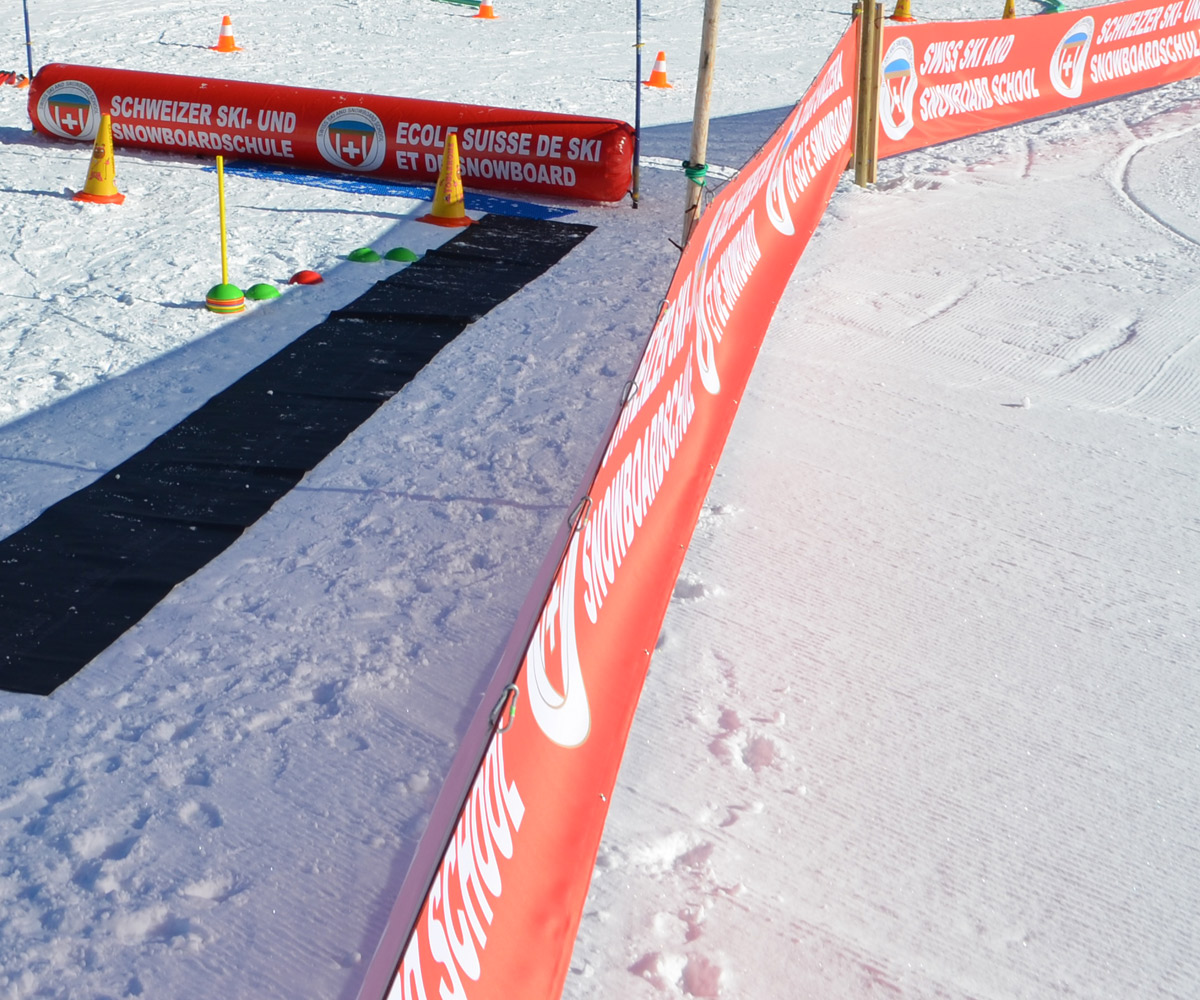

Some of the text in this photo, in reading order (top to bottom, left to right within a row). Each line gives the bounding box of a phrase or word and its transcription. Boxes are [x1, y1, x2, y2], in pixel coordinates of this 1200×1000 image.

[1096, 6, 1165, 45] SCHWEIZER
[1159, 1, 1185, 30] SKI-
[919, 40, 964, 76] SWISS
[959, 37, 989, 70] SKI
[982, 34, 1015, 67] AND
[1090, 28, 1200, 84] SNOWBOARDSCHUL
[991, 67, 1040, 106] SCHOOL
[110, 95, 297, 134] SCHWEIZER SKI- UND
[111, 122, 295, 158] SNOWBOARDSCHULE
[461, 128, 532, 156] SUISSE
[536, 134, 563, 158] DE
[567, 137, 603, 163] SKI
[804, 135, 816, 179] E
[396, 150, 420, 171] ET
[459, 157, 576, 187] SNOWBOARD
